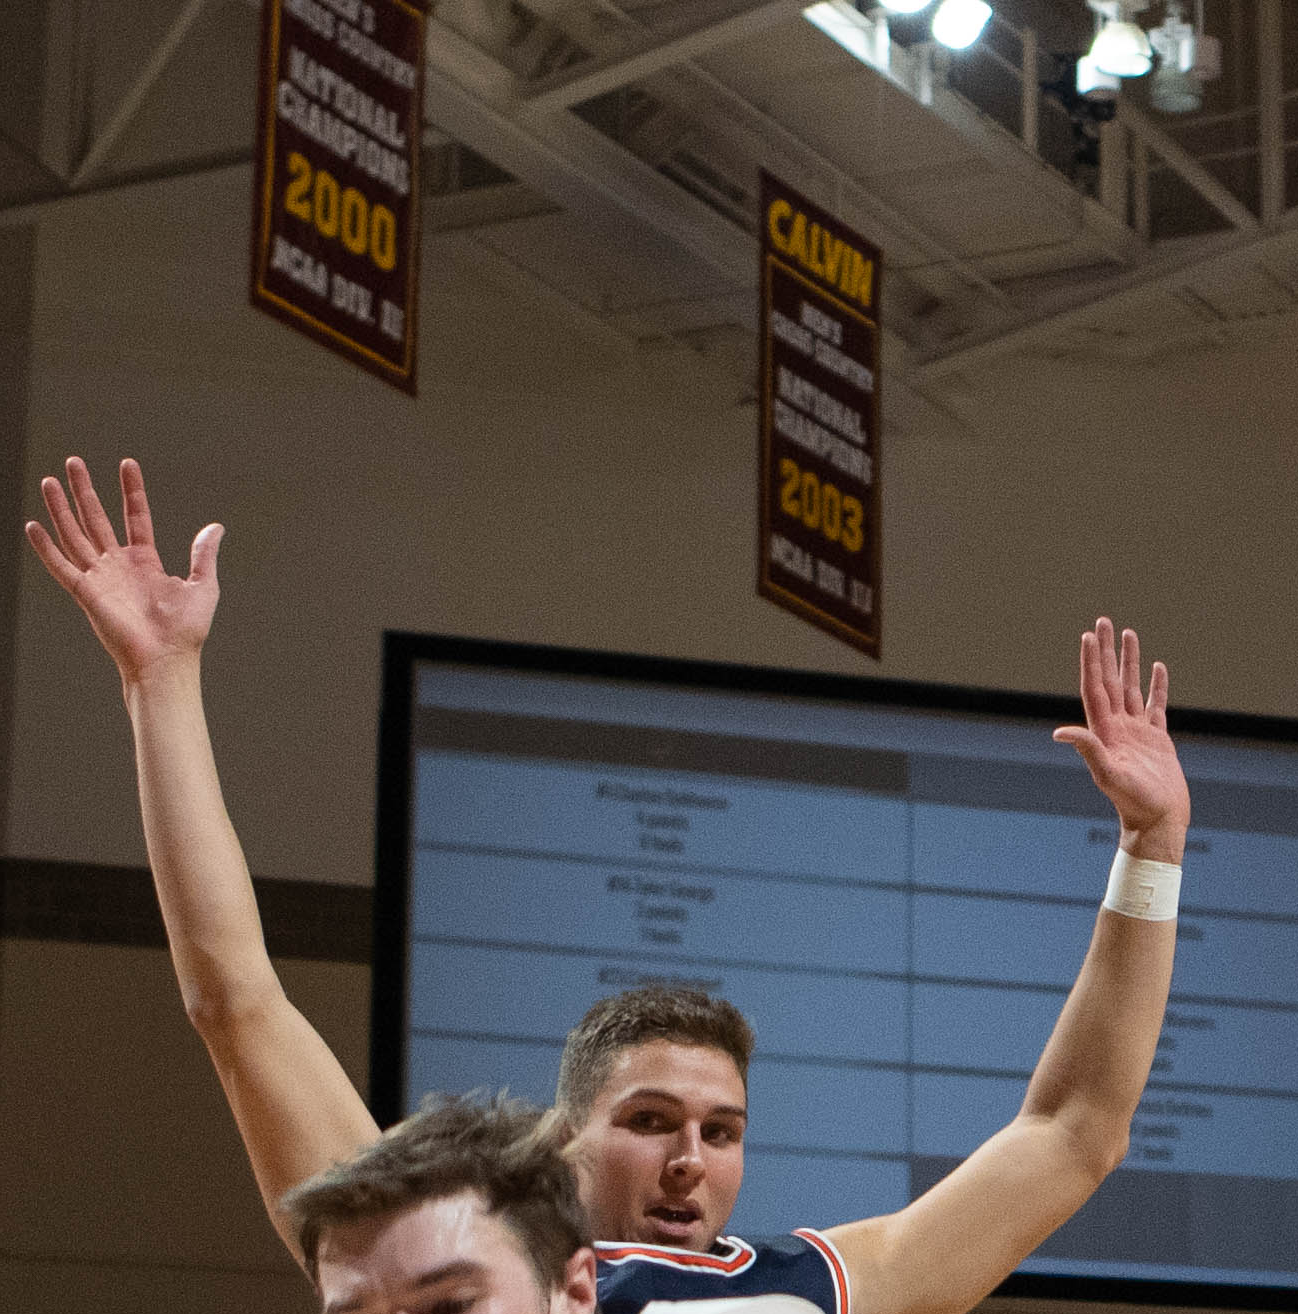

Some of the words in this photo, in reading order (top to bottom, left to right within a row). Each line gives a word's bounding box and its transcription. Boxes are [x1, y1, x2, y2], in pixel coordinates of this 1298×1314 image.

[277, 80, 411, 197] CHAMPIONS
[289, 44, 406, 150] NATIONAL
[284, 151, 397, 272] 2000
[768, 199, 873, 307] CALVIN
[270, 234, 329, 298] NCAA
[779, 457, 864, 553] 2003
